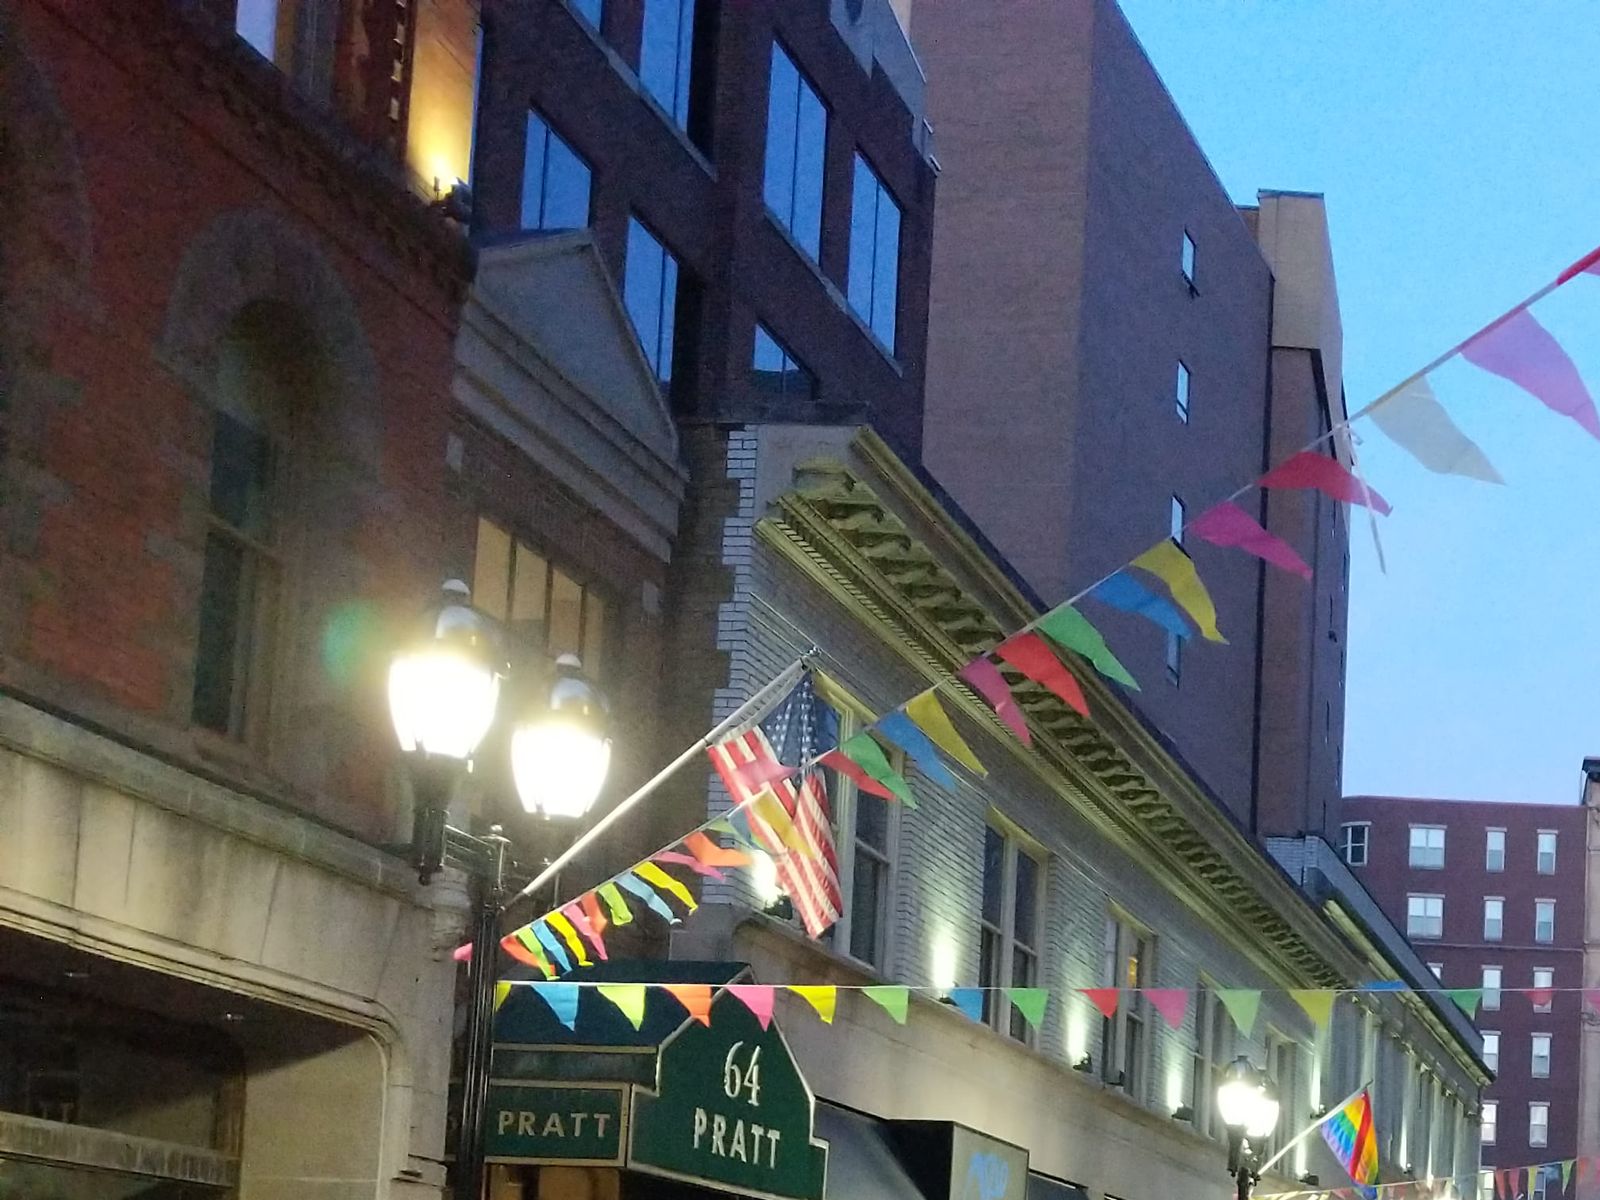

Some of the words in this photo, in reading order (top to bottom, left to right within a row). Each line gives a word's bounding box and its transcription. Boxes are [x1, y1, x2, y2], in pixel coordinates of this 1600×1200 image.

[724, 1041, 761, 1107] 64
[497, 1109, 611, 1138] PRATT
[694, 1107, 781, 1169] PRATT
